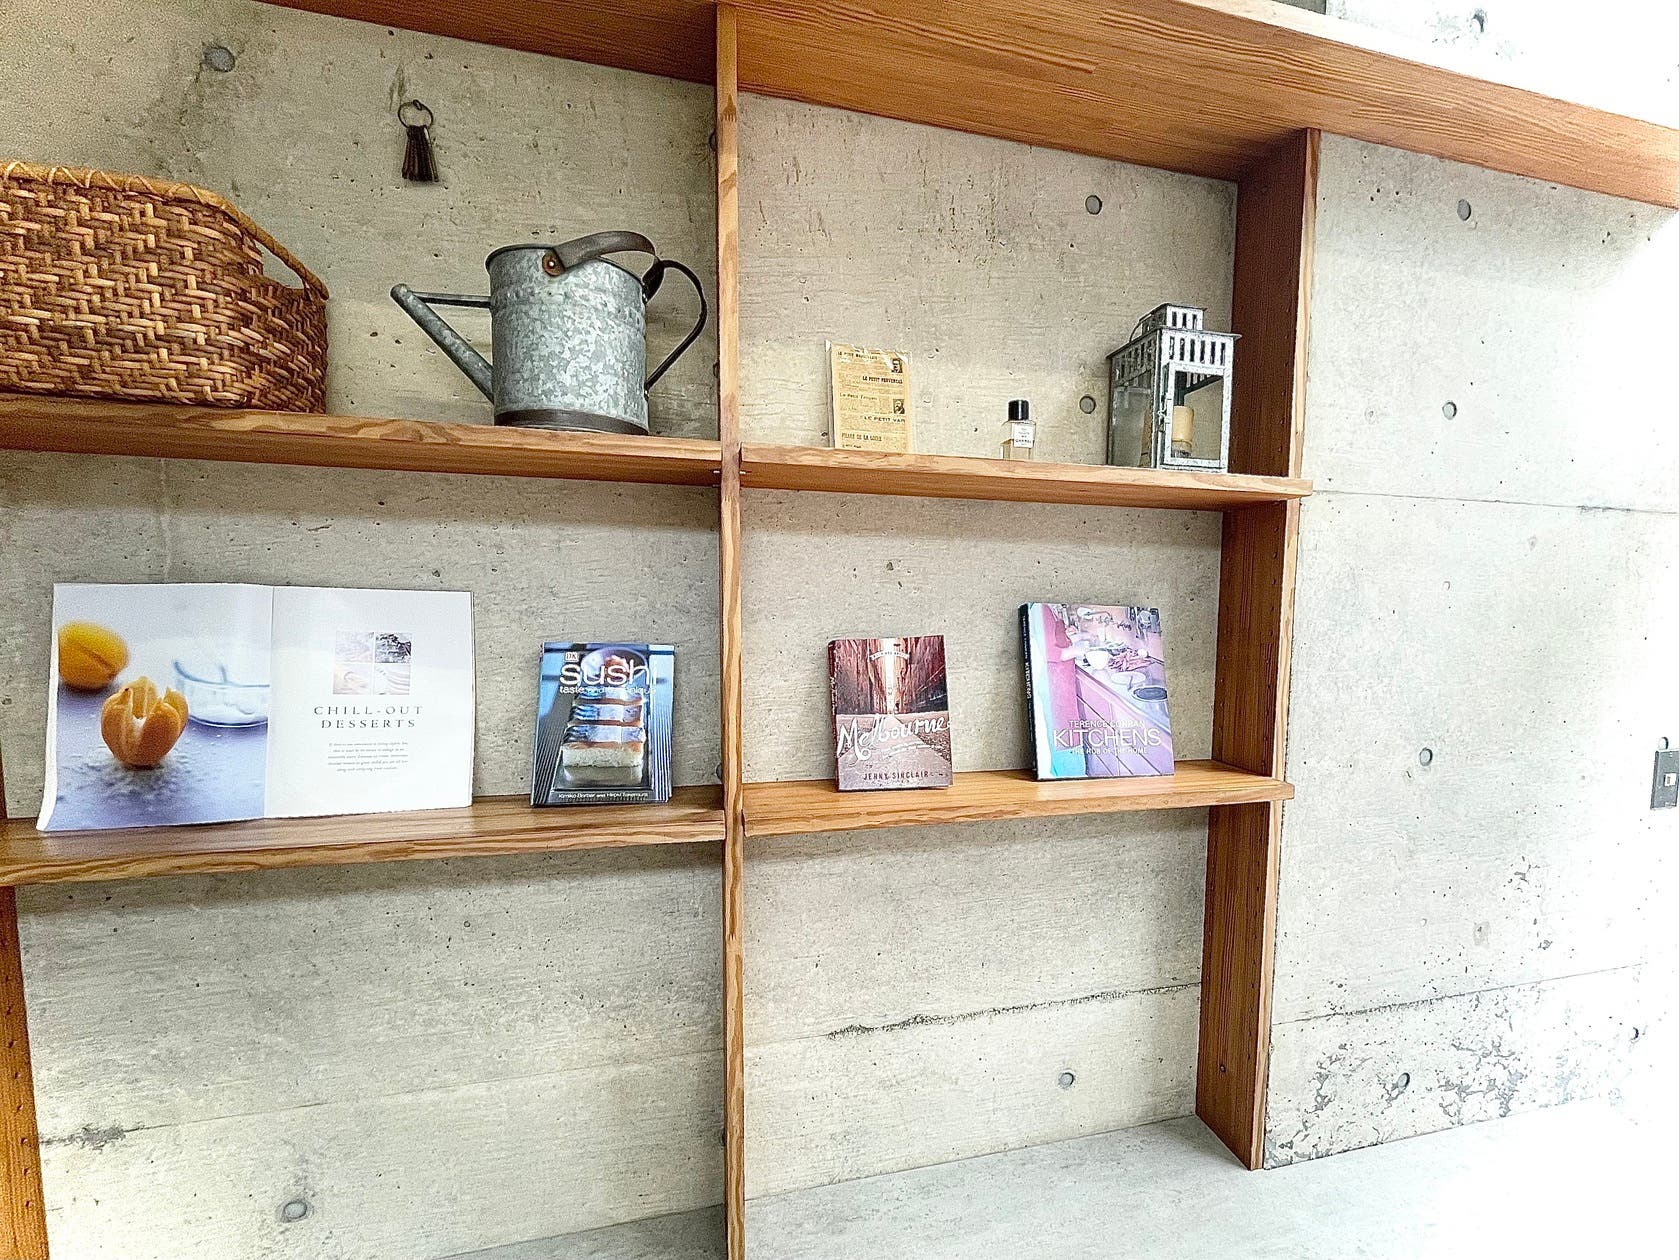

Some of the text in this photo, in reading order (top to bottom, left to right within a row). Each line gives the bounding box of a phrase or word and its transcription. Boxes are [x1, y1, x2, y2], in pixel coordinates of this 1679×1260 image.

[560, 686, 584, 694] taste
[313, 705, 424, 716] CHILL-OUT
[321, 718, 416, 729] DESSERTS
[1069, 720, 1107, 728] TERENCE
[837, 713, 951, 762] Melbourne
[1053, 728, 1162, 748] KITCHENS
[863, 770, 929, 781] JENNY SINCLAIR
